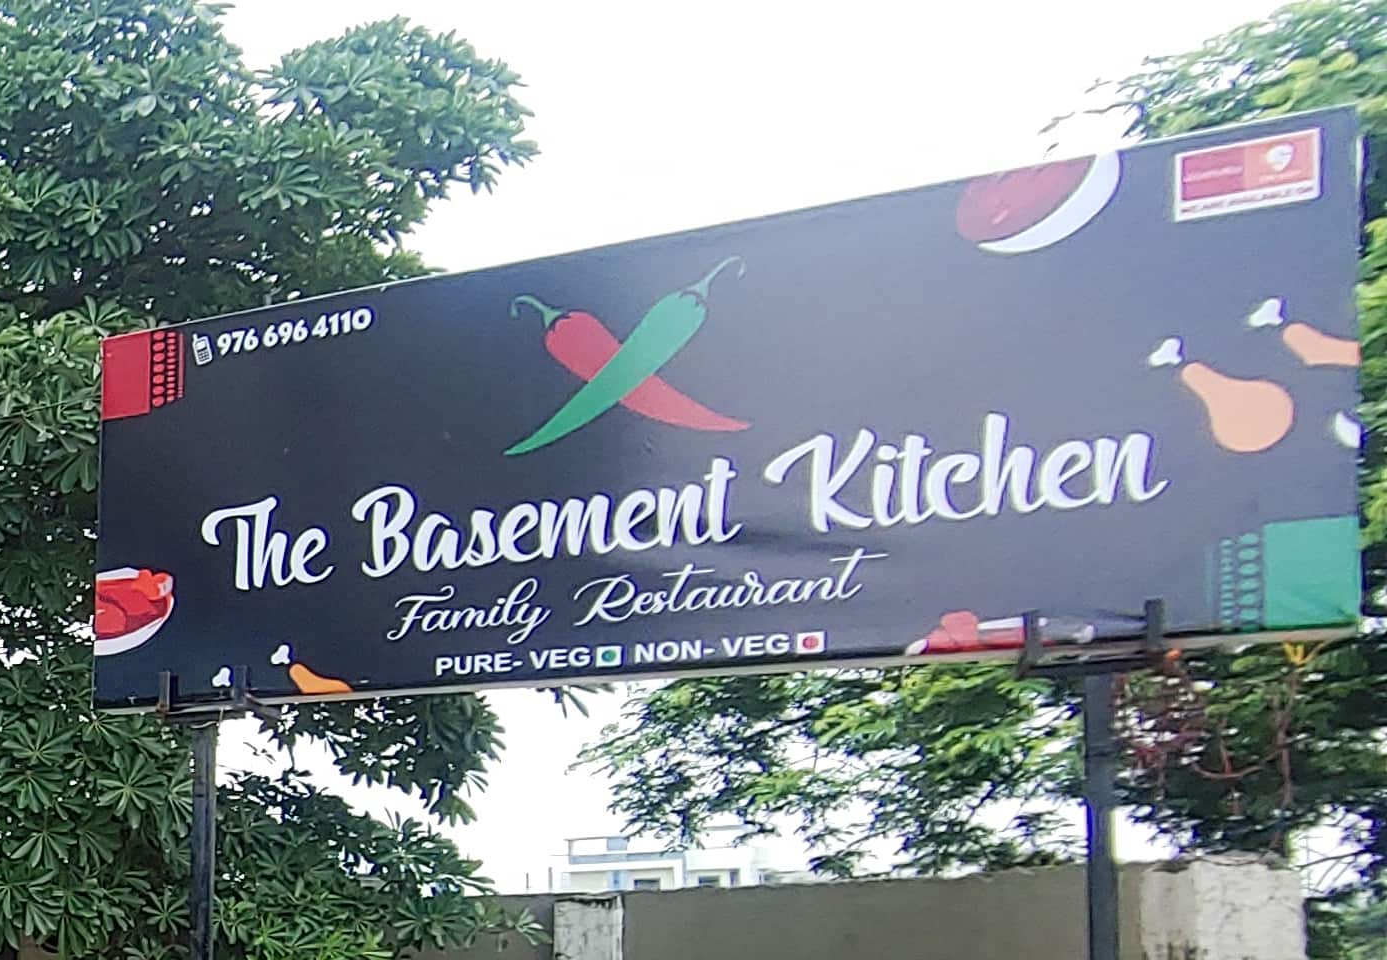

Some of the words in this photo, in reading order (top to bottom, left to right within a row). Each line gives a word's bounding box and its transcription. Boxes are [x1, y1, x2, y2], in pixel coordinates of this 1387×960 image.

[216, 328, 259, 356] 976
[262, 319, 309, 345] 696
[312, 308, 373, 338] 4110
[201, 497, 333, 590] The
[352, 457, 743, 578] Basement
[763, 411, 1171, 533] Kitchen
[387, 578, 551, 644] Family
[573, 547, 889, 627] Restaurant
[434, 653, 524, 677] PURE-
[529, 646, 591, 671] VEG
[633, 640, 717, 664] NON-
[721, 632, 790, 657] VEG
